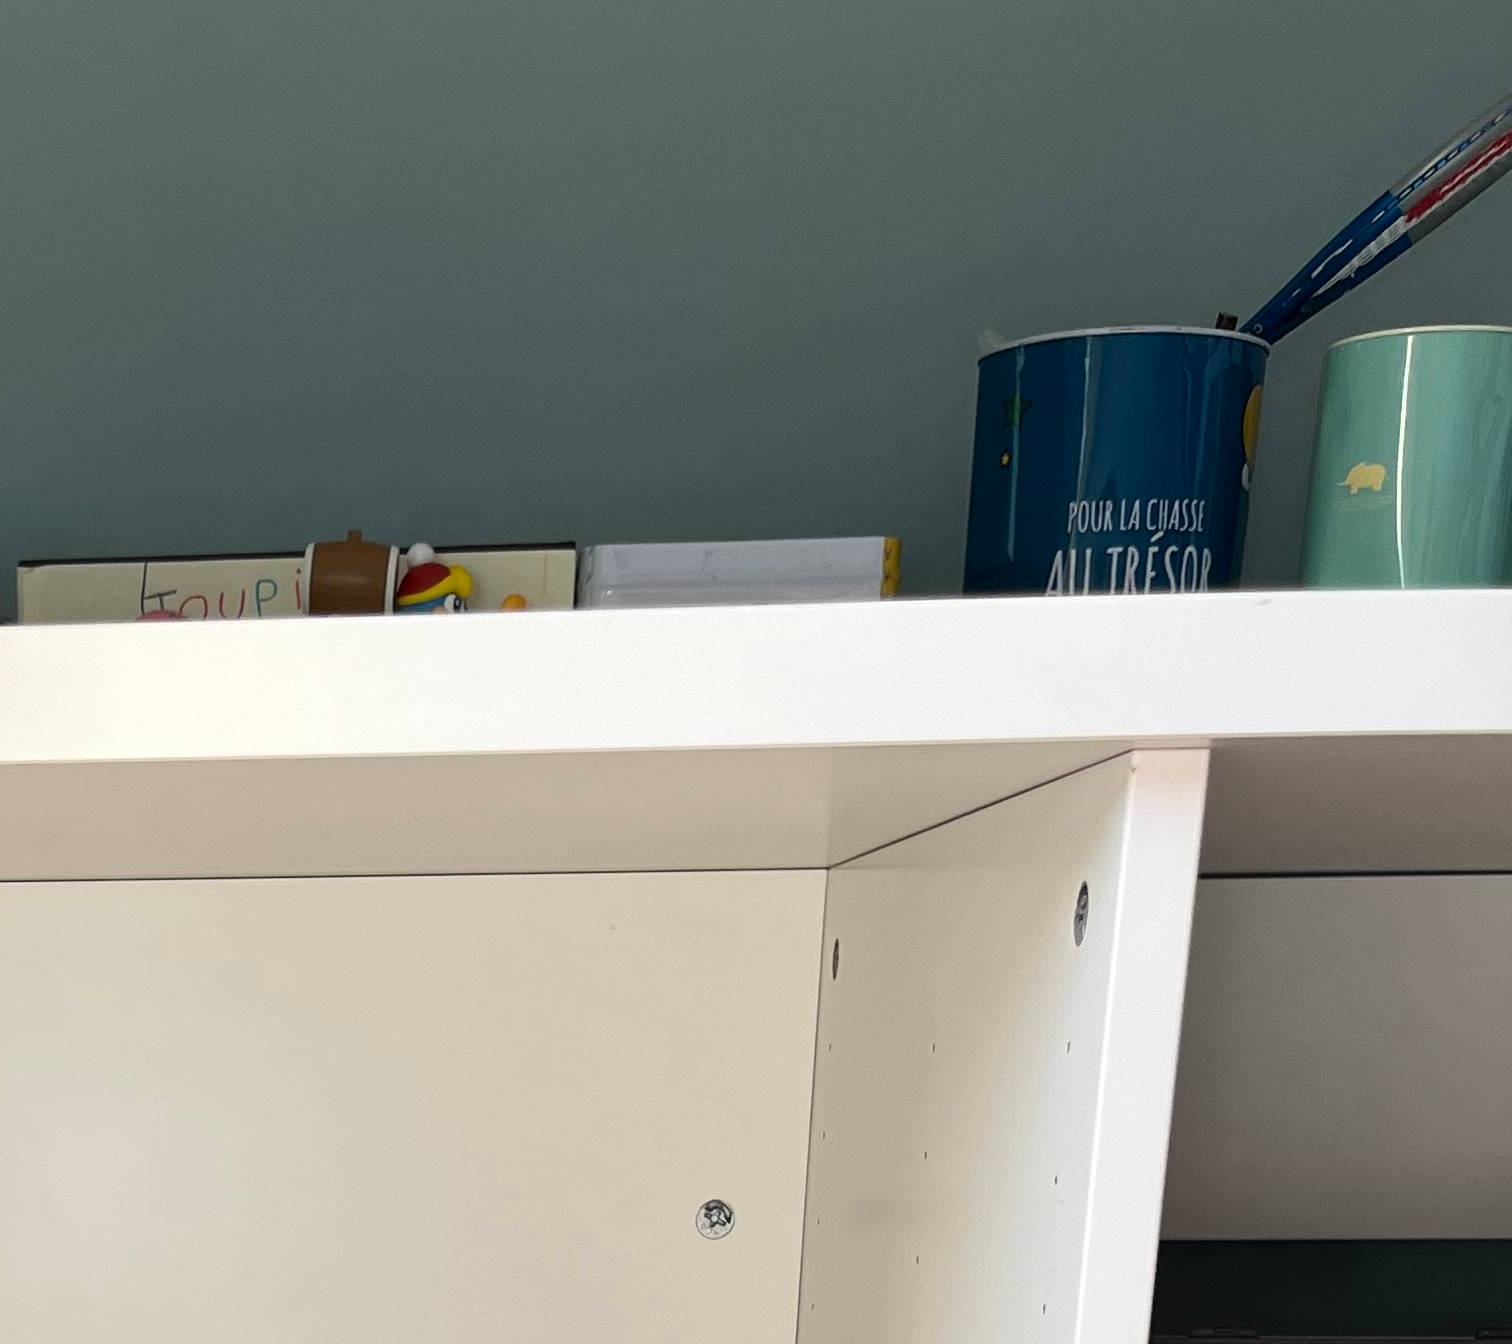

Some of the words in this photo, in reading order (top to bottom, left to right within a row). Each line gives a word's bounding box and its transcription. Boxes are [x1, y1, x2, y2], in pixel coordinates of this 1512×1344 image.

[1068, 501, 1113, 533] POUR
[1119, 499, 1140, 531] LA
[1146, 498, 1206, 533] CHASSE
[1045, 548, 1093, 596] AU
[1106, 531, 1212, 595] TRÉSOR
